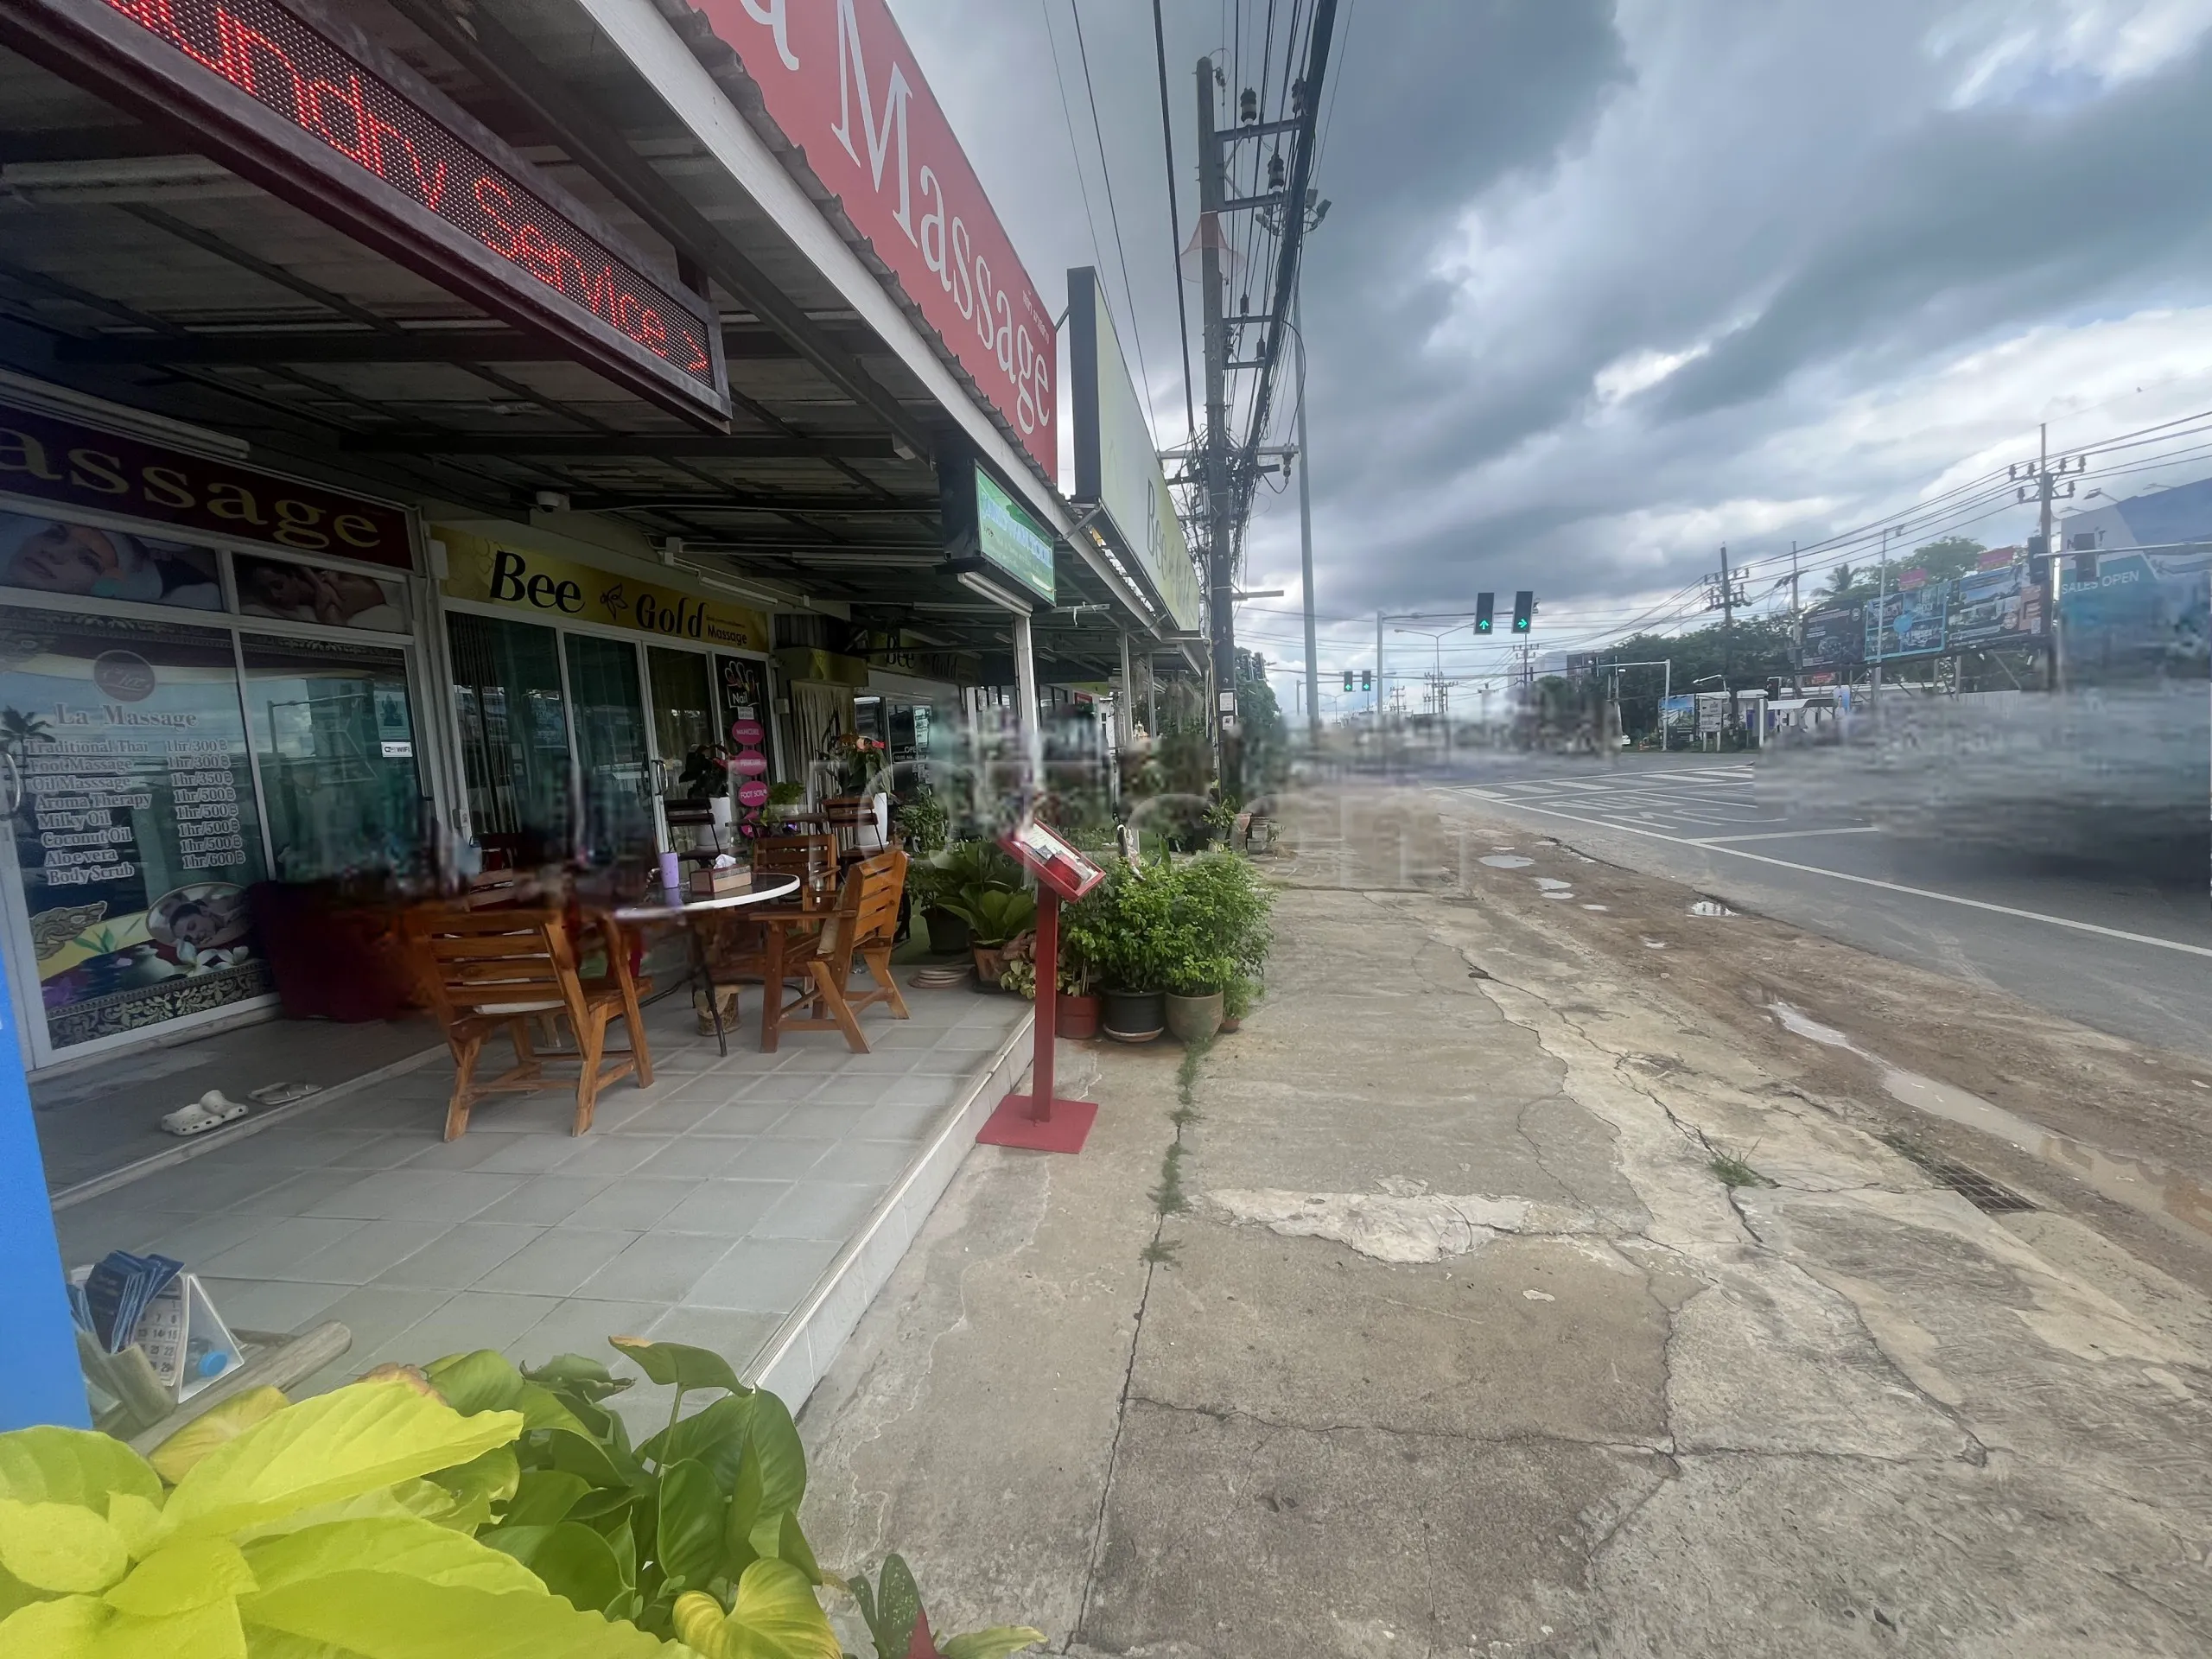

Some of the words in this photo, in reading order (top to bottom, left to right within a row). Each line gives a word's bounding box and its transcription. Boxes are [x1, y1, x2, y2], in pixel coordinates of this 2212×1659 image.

[105, 0, 447, 212] undry
[474, 176, 668, 358] Service
[831, 0, 1050, 435] Massage
[2101, 570, 2139, 587] OPEN
[490, 550, 586, 613] Bee
[636, 594, 709, 638] Gold
[708, 625, 747, 645] Massage
[733, 690, 747, 704] Nail
[55, 702, 89, 726] La
[103, 704, 198, 730] Massage
[27, 740, 112, 753] Traditional
[118, 740, 149, 753] Thai
[29, 759, 67, 772] Foot
[68, 758, 132, 773] Massage
[36, 796, 87, 810] Aroma
[90, 793, 152, 810] Therapy
[37, 812, 86, 830] Milky
[87, 810, 111, 825] Oil
[1601, 808, 1788, 830] MC
[41, 831, 108, 848] Coconut
[109, 827, 133, 842] Oil
[48, 867, 89, 886] Body
[91, 861, 135, 880] Scrub
